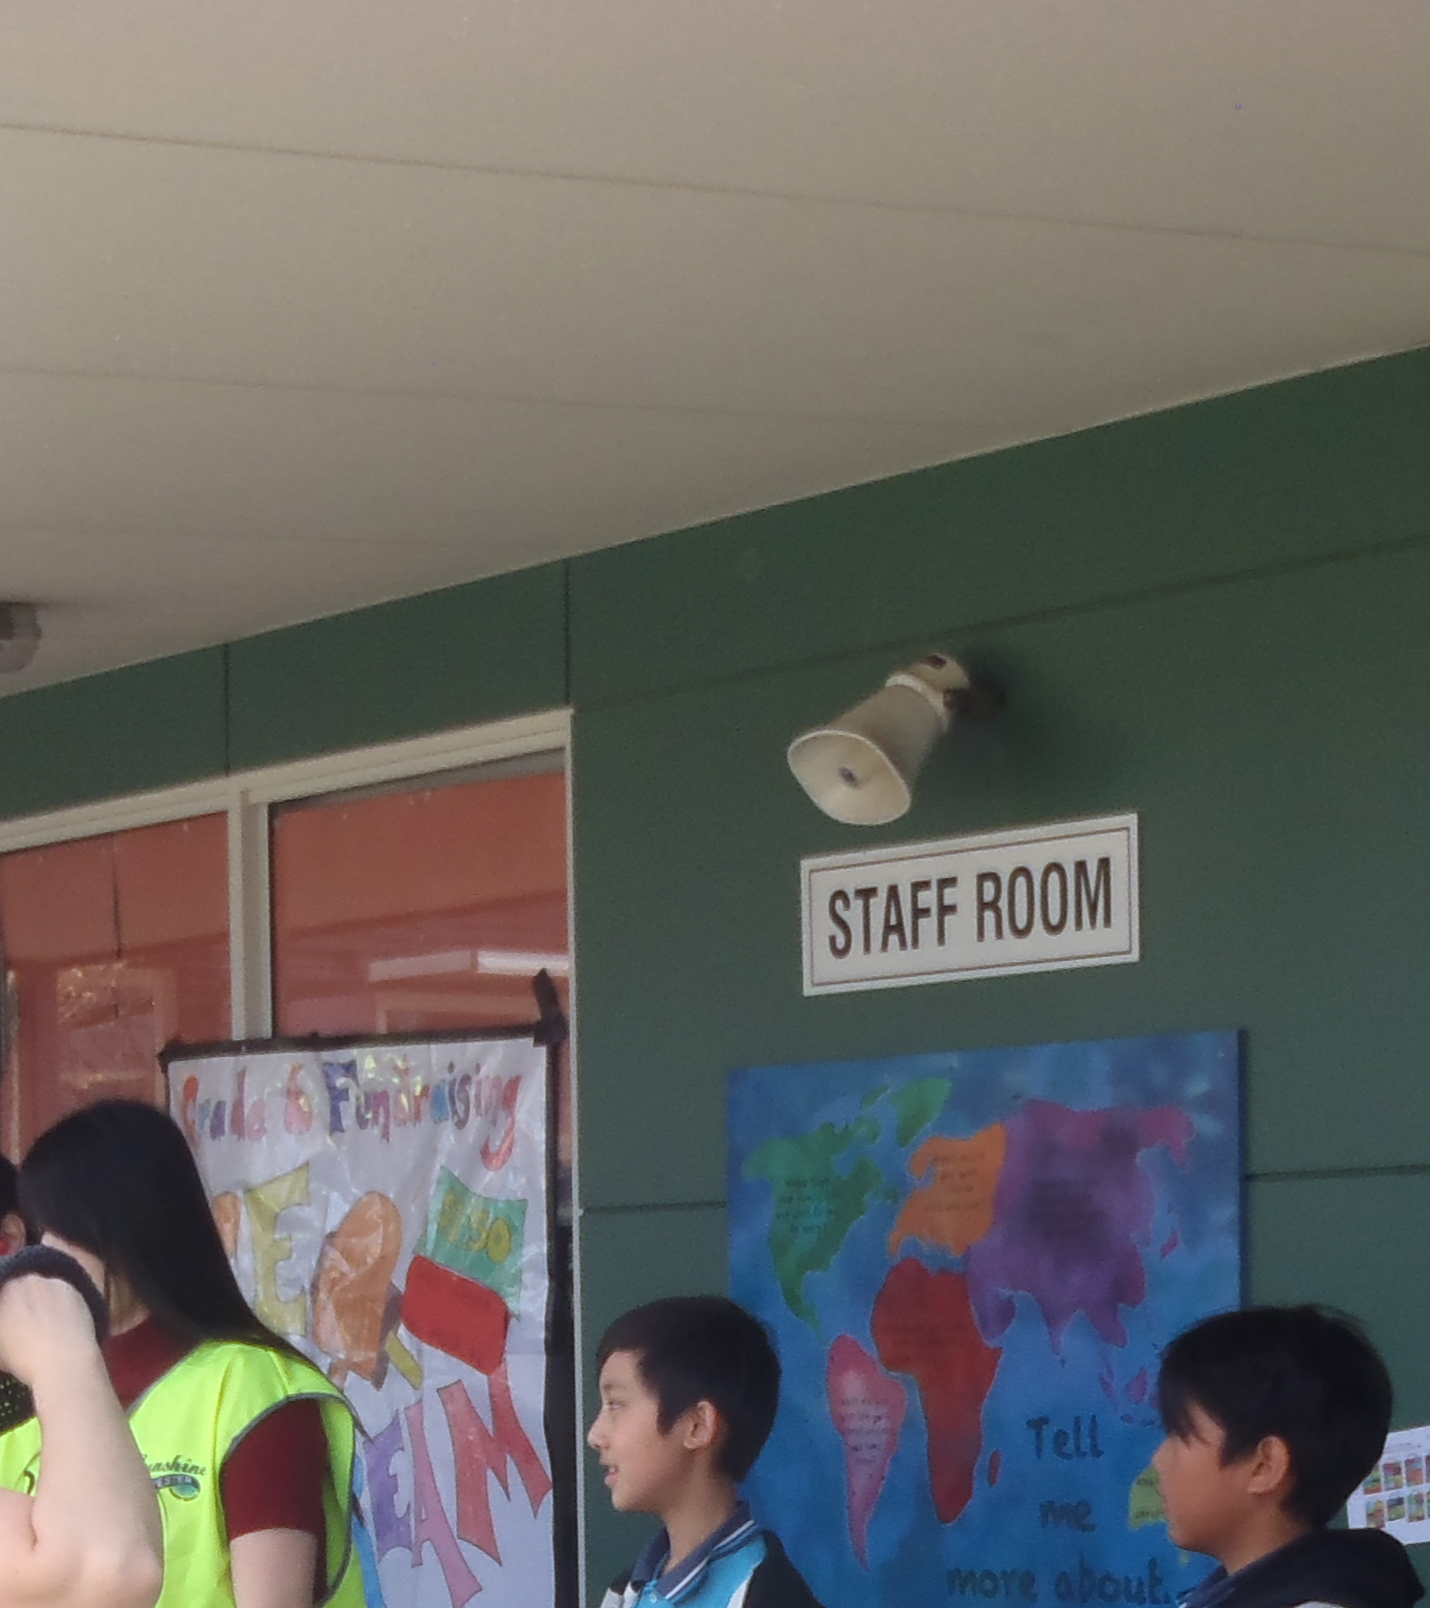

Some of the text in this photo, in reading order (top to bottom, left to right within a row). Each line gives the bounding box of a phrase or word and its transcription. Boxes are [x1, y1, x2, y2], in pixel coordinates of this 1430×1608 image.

[828, 855, 1112, 960] STAFF ROOM
[283, 1062, 314, 1135] 6
[321, 1053, 522, 1171] Fundraising
[1025, 1414, 1104, 1461] Tell
[1039, 1499, 1097, 1533] me
[946, 1566, 1039, 1603] more
